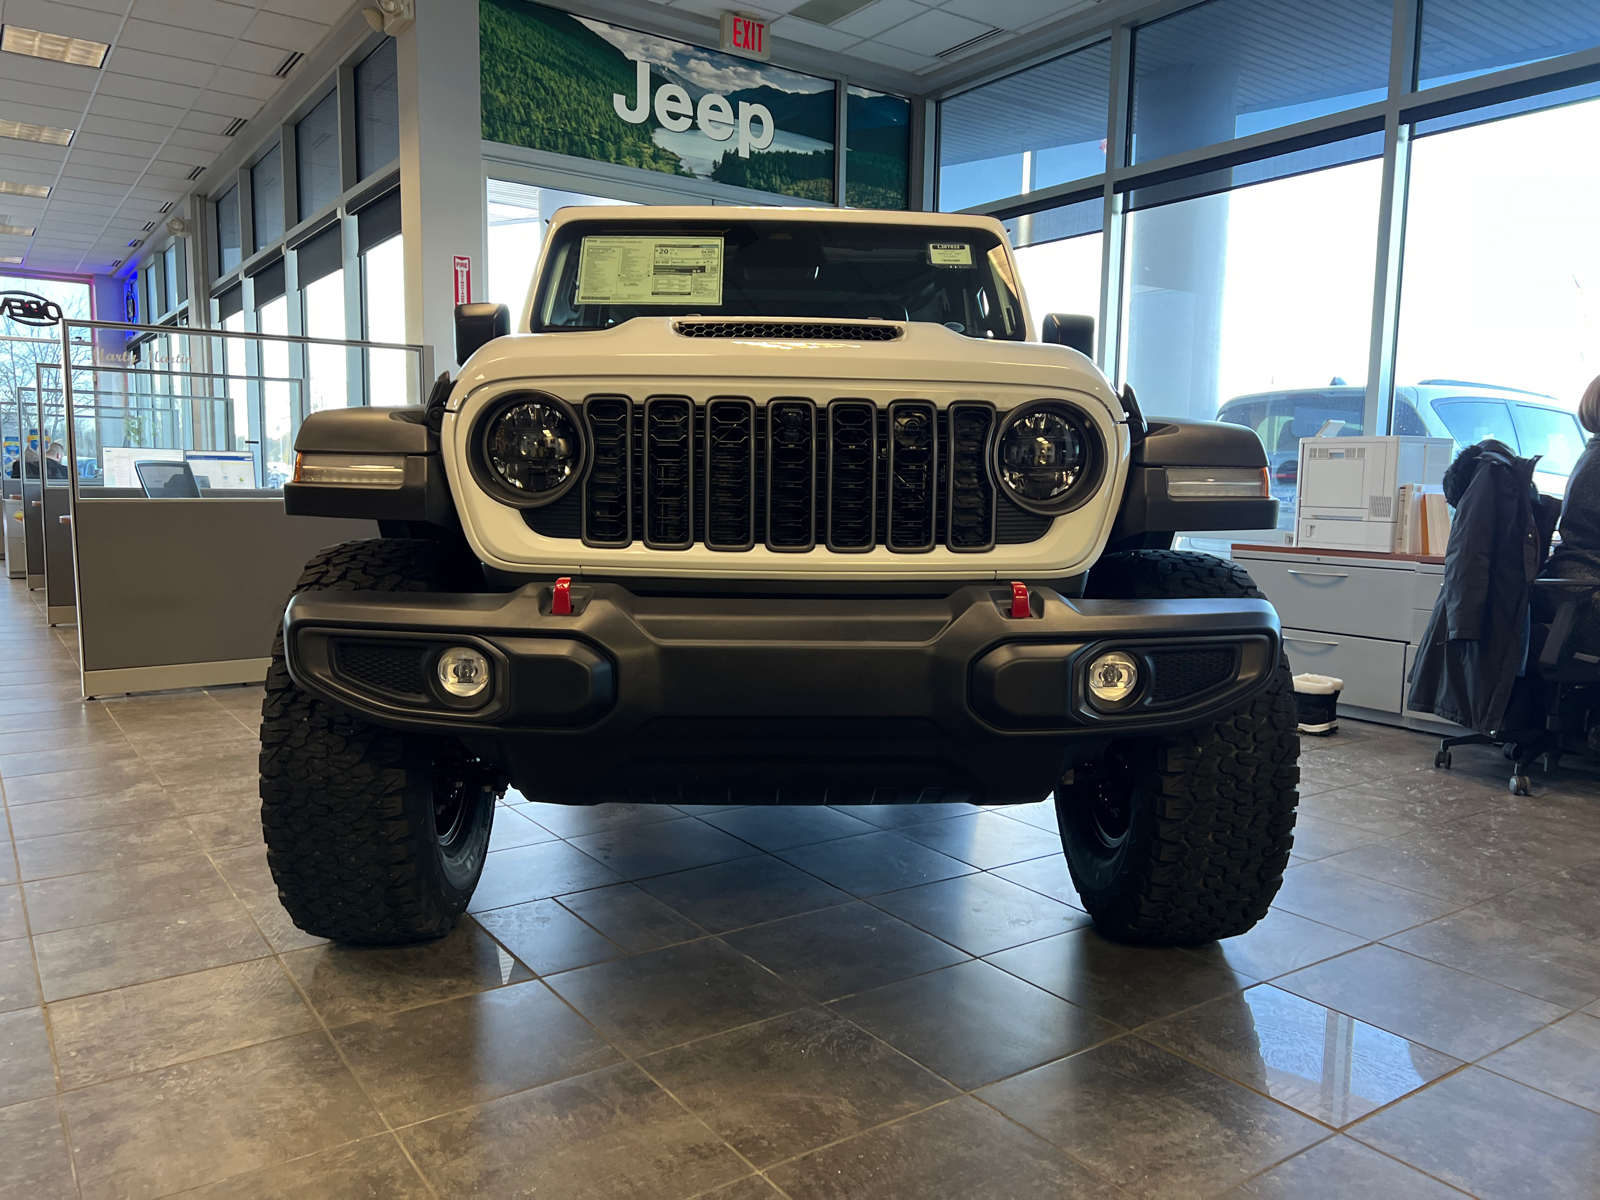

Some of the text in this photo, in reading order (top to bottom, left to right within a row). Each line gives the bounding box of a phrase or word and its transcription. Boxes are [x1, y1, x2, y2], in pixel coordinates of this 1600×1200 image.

[733, 17, 764, 52] EXIT
[613, 60, 775, 159] Jeep
[456, 261, 468, 269] FIRE
[88, 348, 194, 365] Marty Martin
